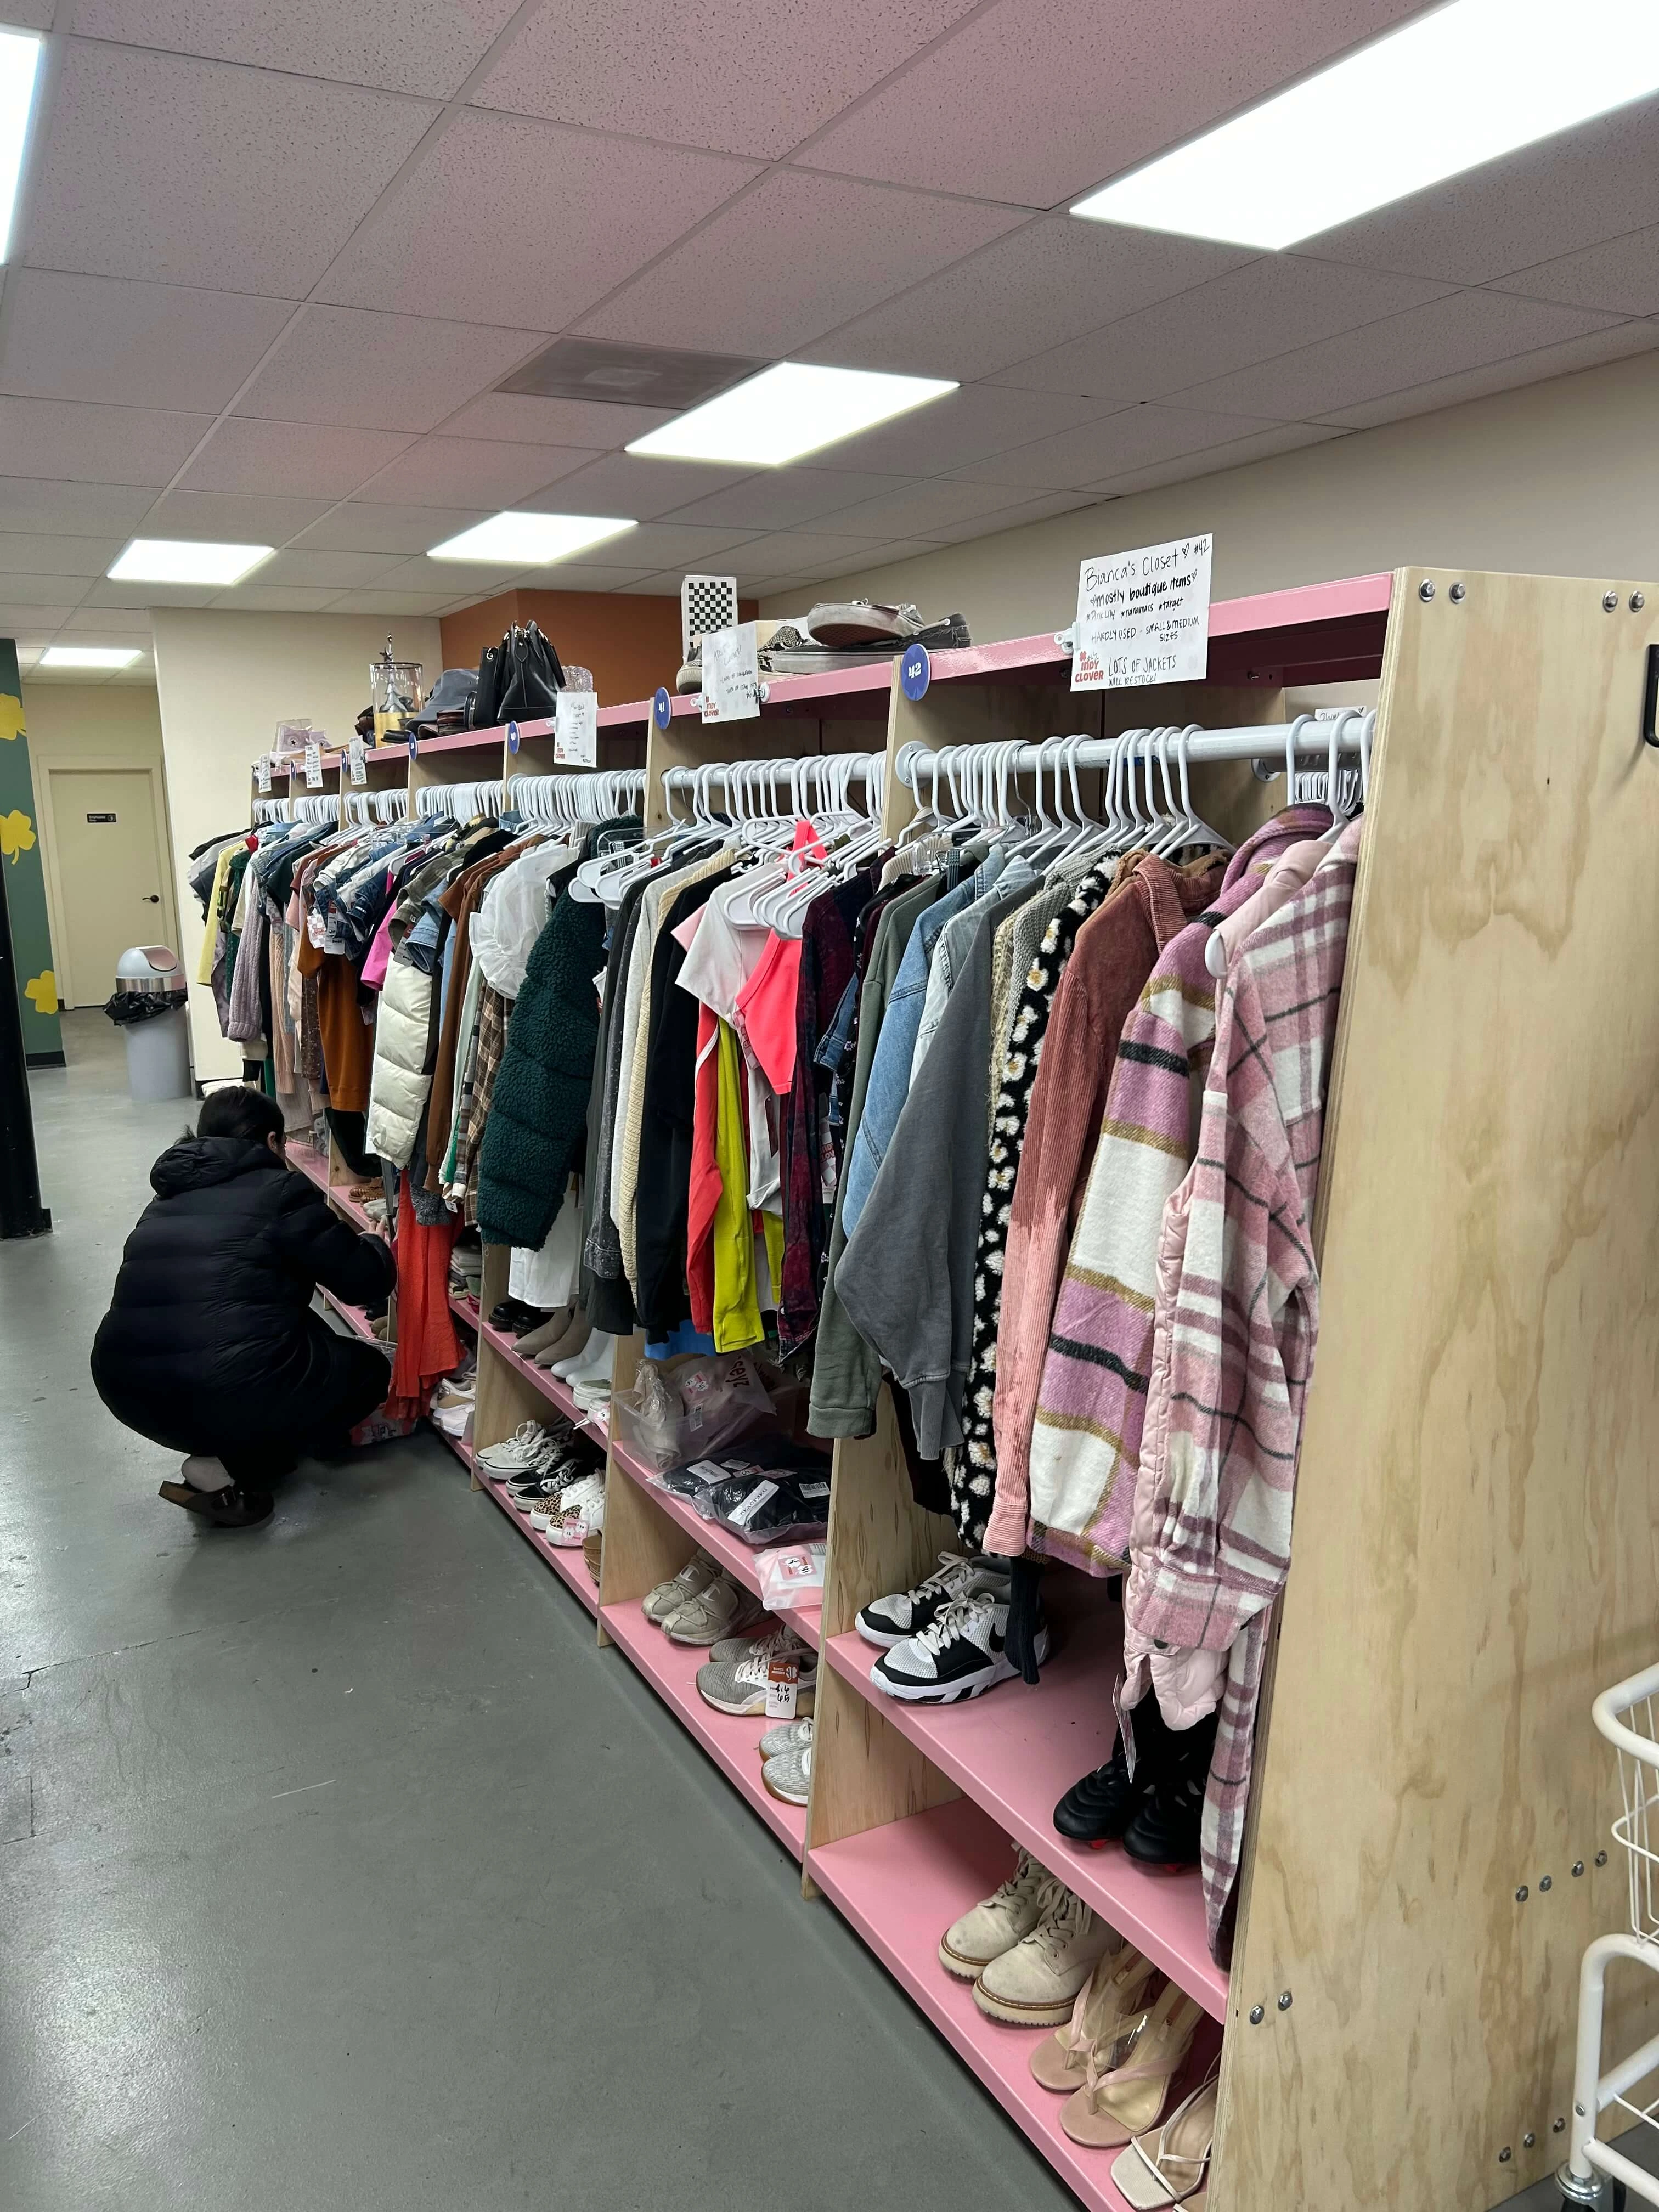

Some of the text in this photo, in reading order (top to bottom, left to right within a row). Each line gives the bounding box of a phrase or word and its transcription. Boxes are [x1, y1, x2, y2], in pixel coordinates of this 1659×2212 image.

[1085, 538, 1210, 591] Bianca's Closet #42
[1096, 574, 1191, 608] mostly boutique items
[1091, 631, 1117, 643] HARDLY
[1119, 627, 1137, 640] USED
[1146, 620, 1165, 634] SMALL
[1172, 616, 1199, 629] MEDIUM
[1159, 631, 1178, 642] SIZES
[908, 662, 922, 679] 42
[1109, 654, 1177, 676] LOTS OF JACKETS
[1108, 676, 1122, 686] WILL
[658, 701, 665, 713] 41
